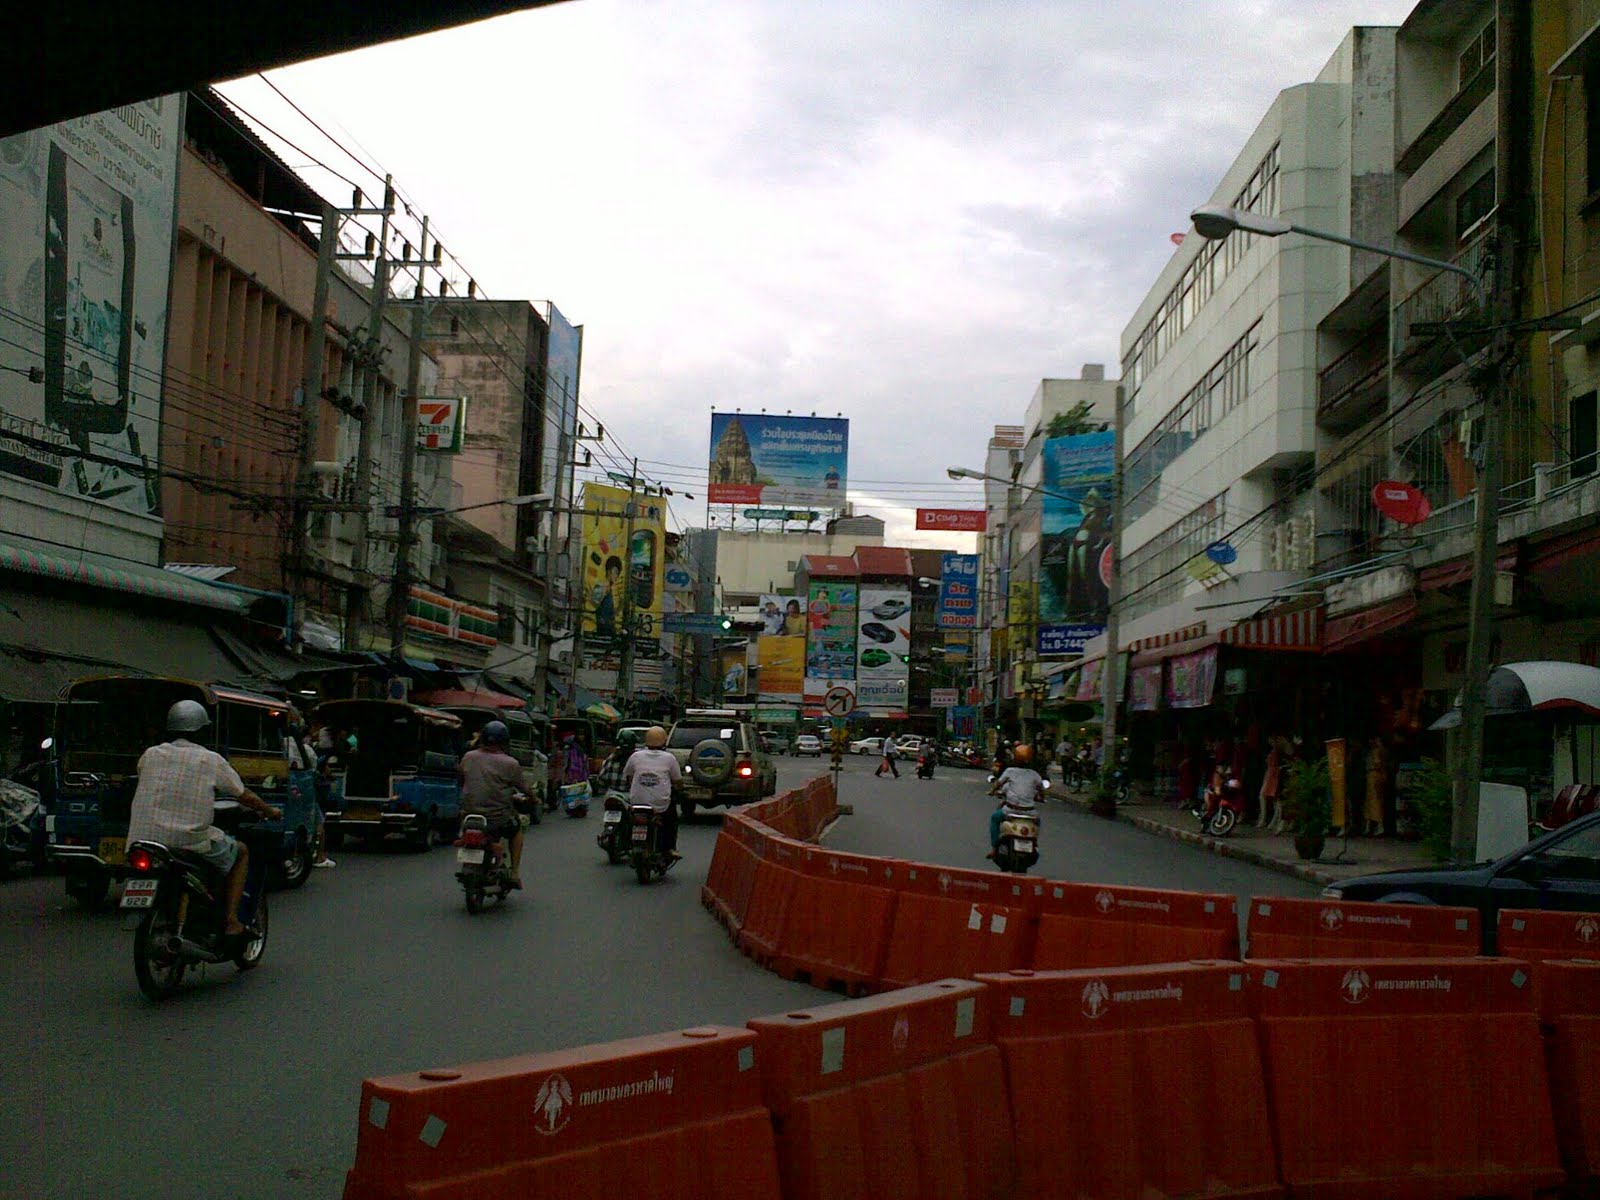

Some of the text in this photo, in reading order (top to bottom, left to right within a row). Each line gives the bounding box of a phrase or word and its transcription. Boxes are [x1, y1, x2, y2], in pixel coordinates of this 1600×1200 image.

[579, 1068, 675, 1107] เทศบาลนครหาดใหญ่
